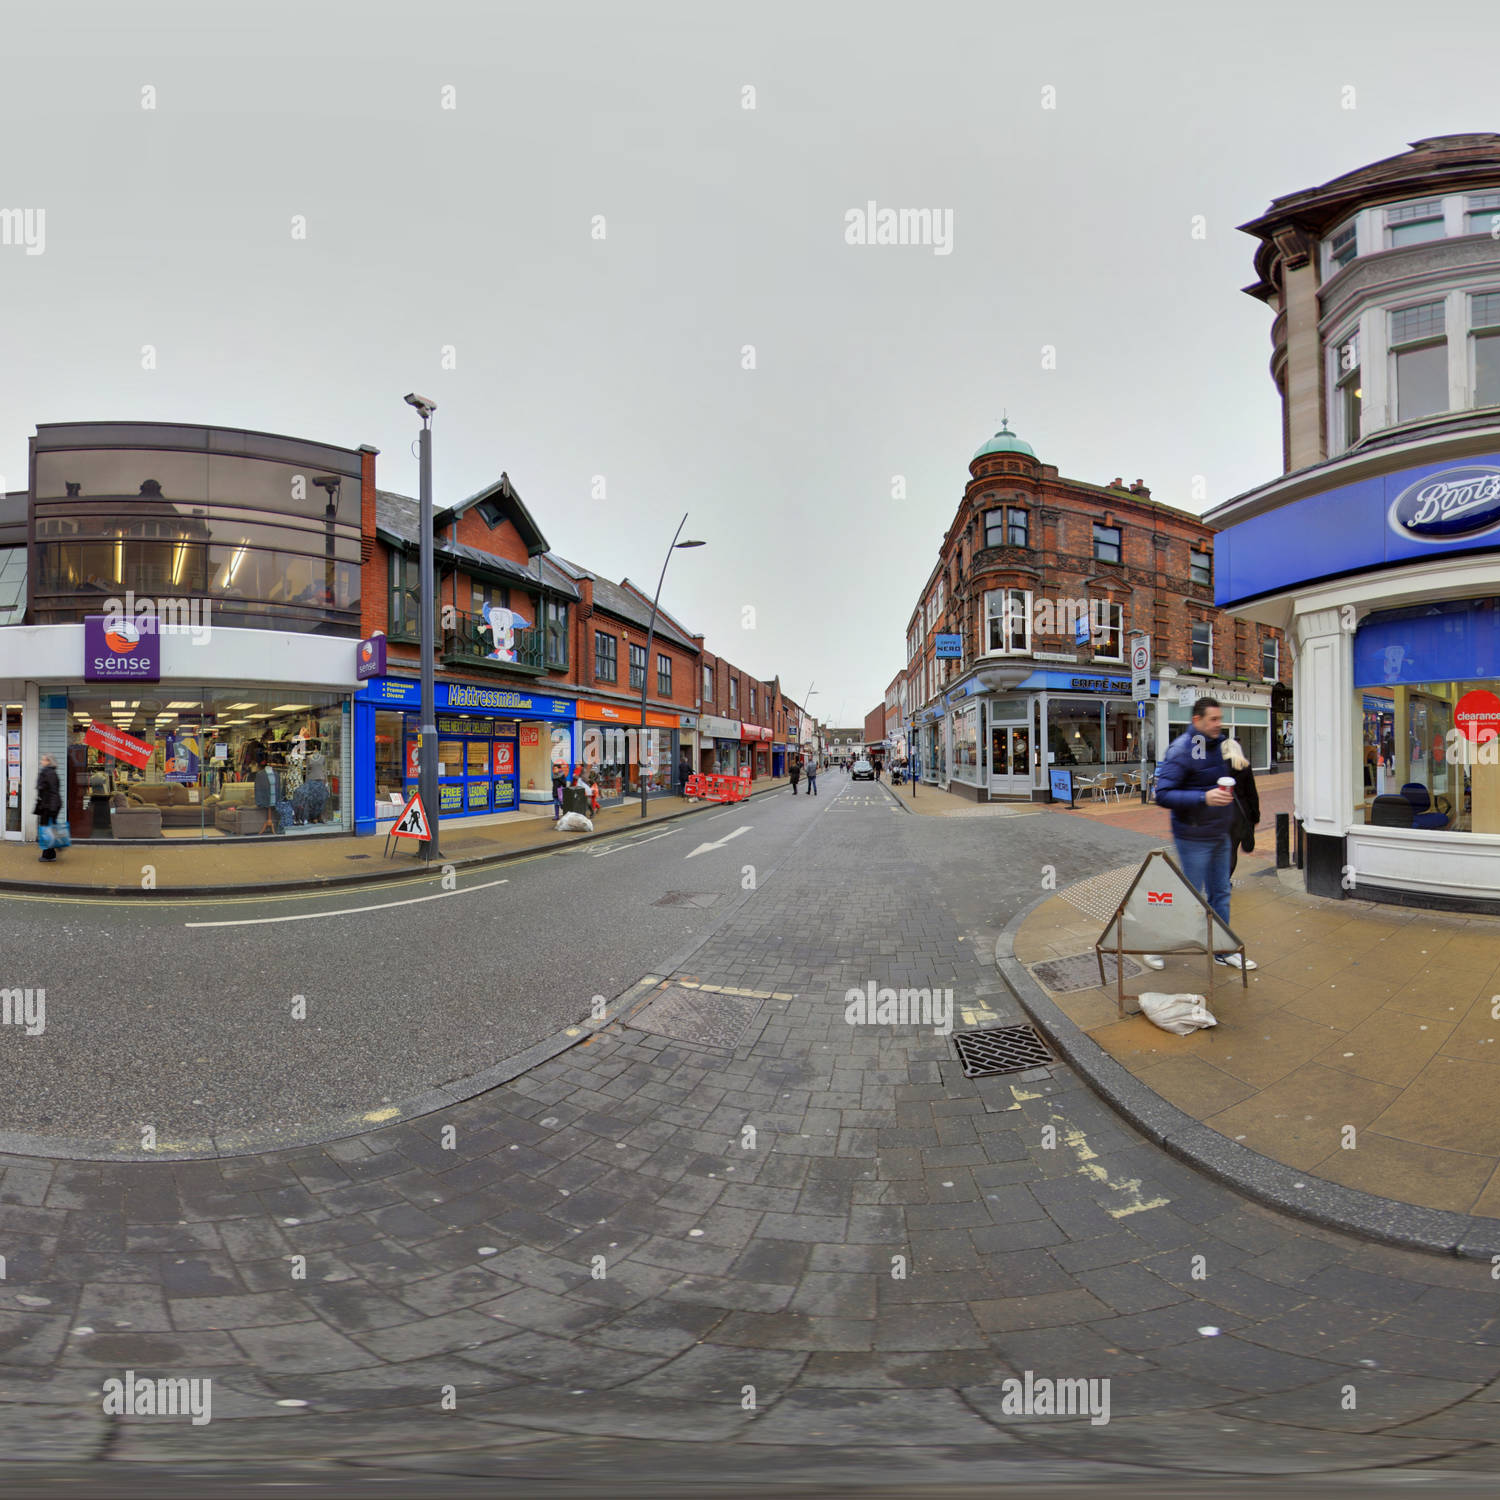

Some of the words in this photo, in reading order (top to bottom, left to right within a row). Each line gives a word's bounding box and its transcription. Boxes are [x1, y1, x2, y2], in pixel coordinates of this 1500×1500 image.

[94, 657, 151, 670] sense
[360, 662, 376, 674] sense
[1195, 689, 1219, 699] RILEY
[1230, 693, 1251, 702] RILEY
[89, 724, 123, 744] Donations
[125, 739, 152, 756] Wanted
[441, 787, 461, 797] FREE
[1055, 782, 1069, 792] NERO
